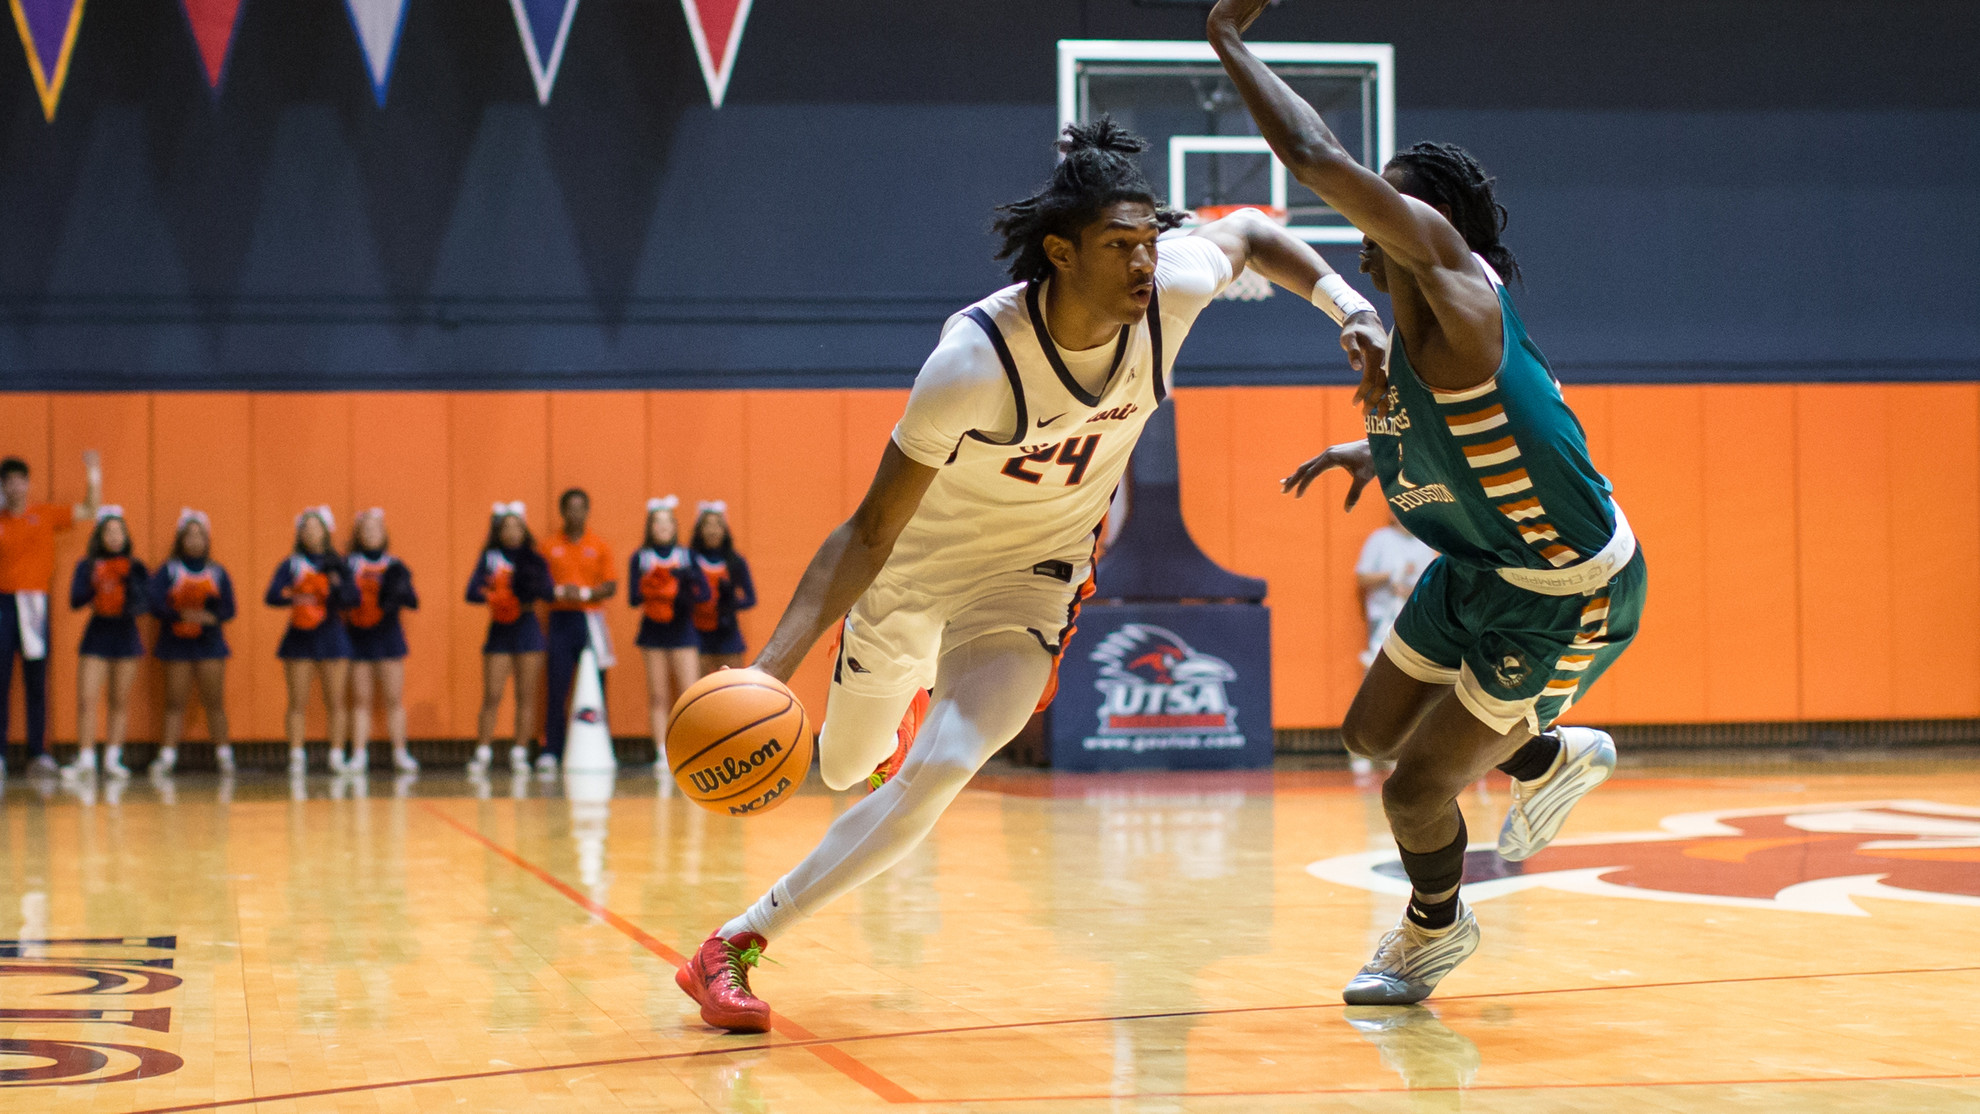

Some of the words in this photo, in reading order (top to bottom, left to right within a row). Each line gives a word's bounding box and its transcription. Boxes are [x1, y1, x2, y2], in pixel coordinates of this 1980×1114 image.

[1000, 433, 1102, 486] 24
[1388, 483, 1456, 512] HOUSTON
[1111, 682, 1226, 715] UTSA
[689, 738, 783, 793] Wilson
[728, 776, 792, 815] NCAA
